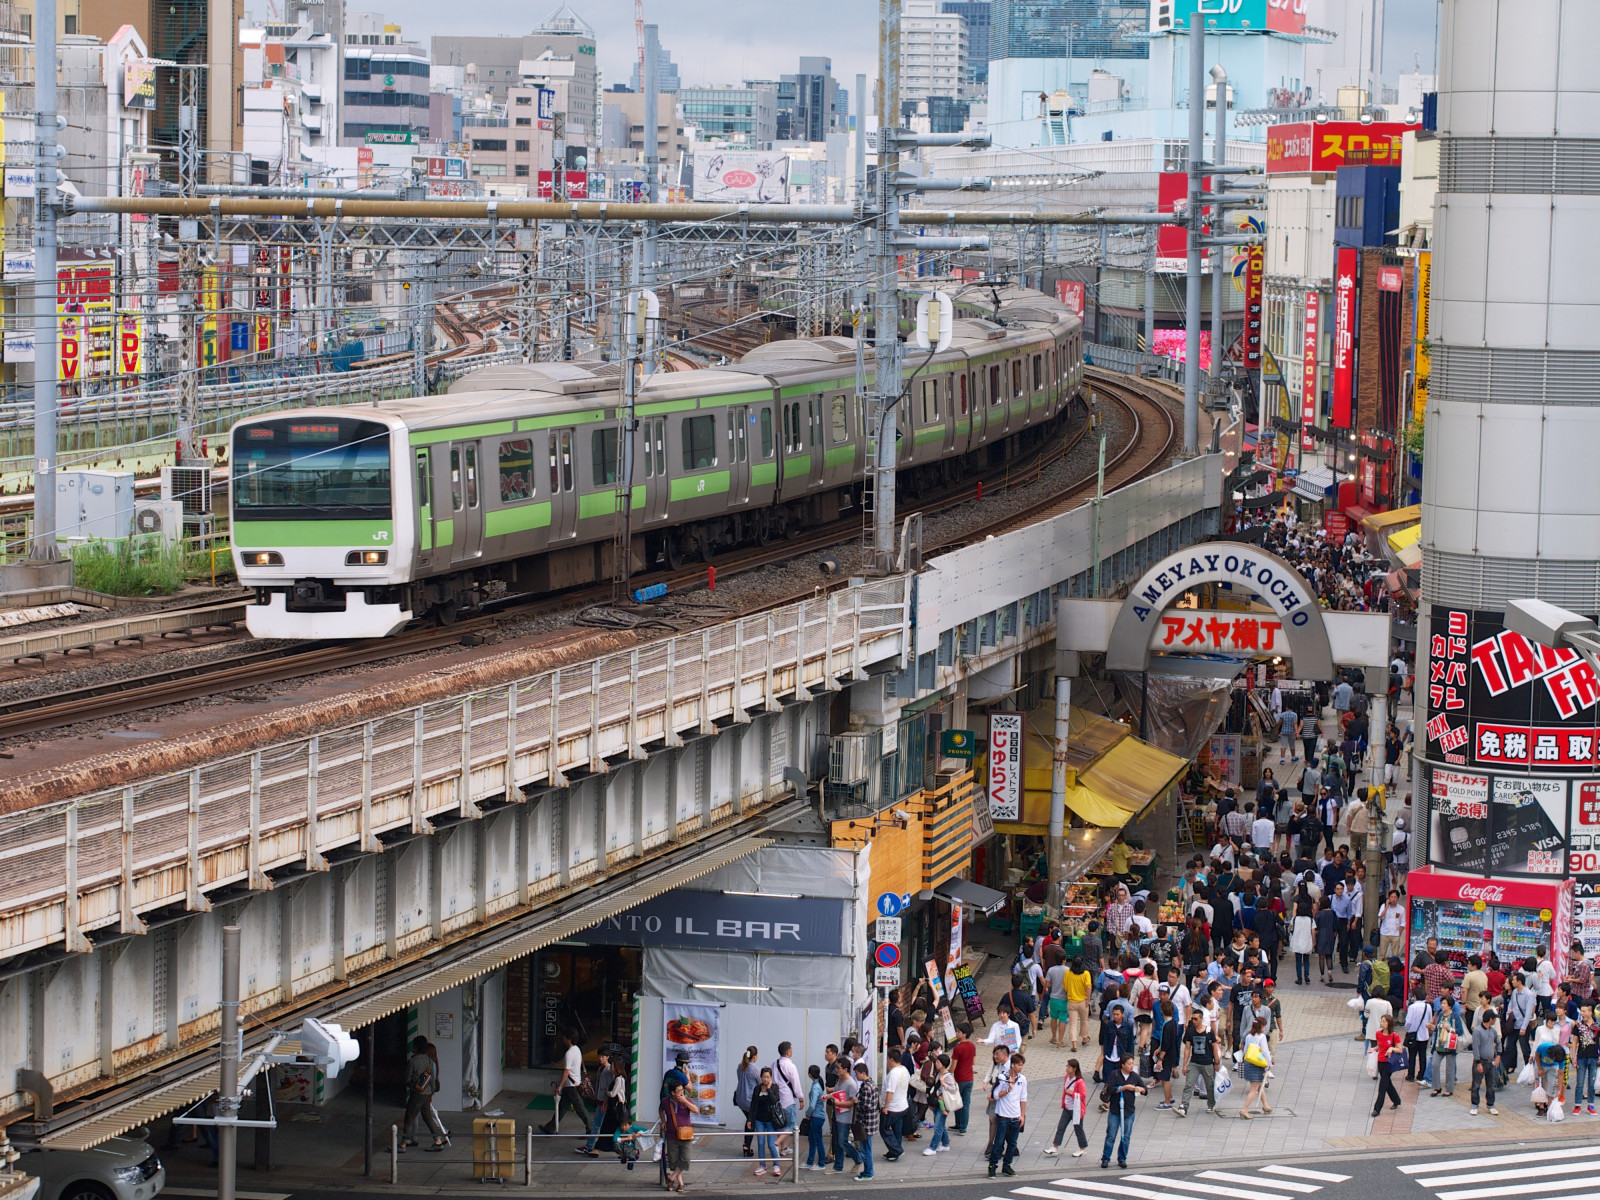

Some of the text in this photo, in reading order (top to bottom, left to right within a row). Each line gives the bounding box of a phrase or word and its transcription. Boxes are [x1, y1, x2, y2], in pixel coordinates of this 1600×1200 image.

[1321, 135, 1402, 160] スロット
[725, 175, 753, 185] GALA
[1250, 246, 1264, 299] スロット
[1339, 291, 1351, 369] GAME
[697, 479, 705, 493] JR
[372, 531, 388, 541] JR
[1133, 554, 1309, 627] AMEYAYOKOCHO
[1161, 616, 1282, 650] アメヤ横丁
[1430, 634, 1447, 708] カメラ
[1445, 611, 1467, 710] ヨドバシ
[1426, 713, 1451, 742] TAX
[1439, 725, 1469, 754] FREE
[1480, 730, 1600, 762] 免税品取
[991, 731, 1007, 803] じゅらく
[1445, 753, 1466, 765] STORE
[1433, 770, 1561, 793] ヨドバシカメラ でお買い物なら
[1449, 787, 1466, 795] GOLD
[1466, 789, 1487, 797] POINT
[1494, 791, 1513, 800] CARD
[1532, 835, 1562, 851] VISA
[1458, 883, 1506, 902] Coca-Cola
[675, 916, 709, 935] IL
[716, 919, 801, 941] BAR
[1216, 1078, 1232, 1095] GU
